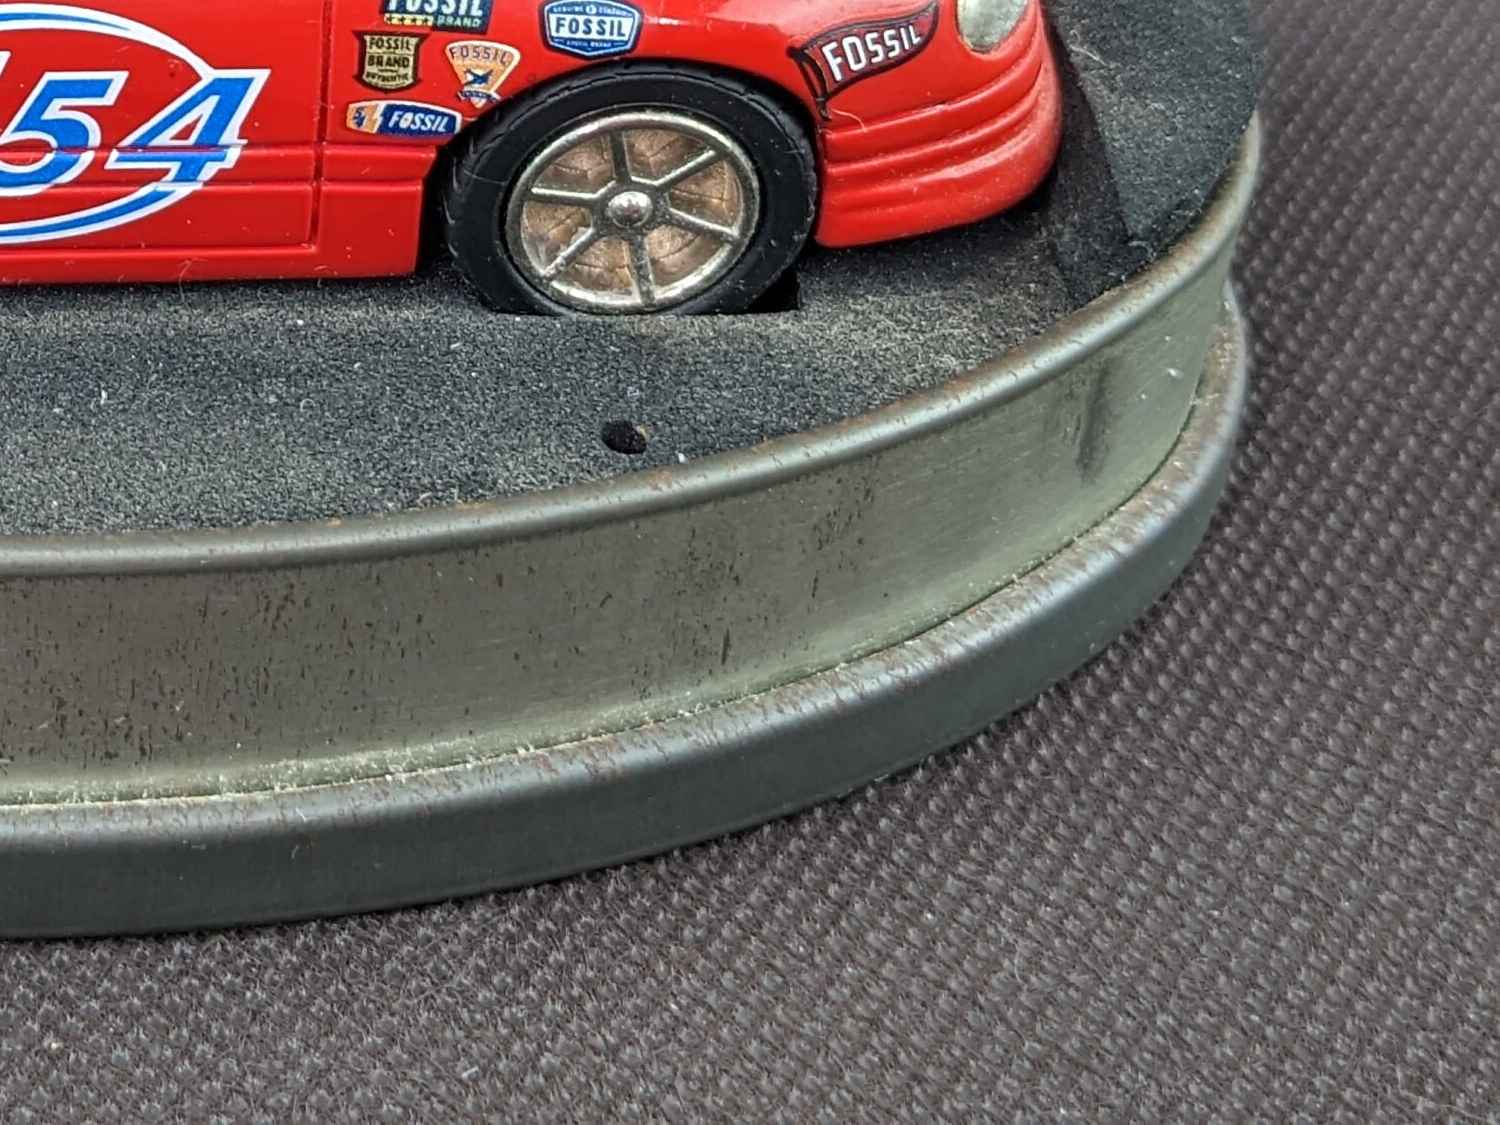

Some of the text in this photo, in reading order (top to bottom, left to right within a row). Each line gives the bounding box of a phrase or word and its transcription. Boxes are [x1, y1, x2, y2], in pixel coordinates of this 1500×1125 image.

[436, 15, 481, 28] BRAND
[554, 16, 627, 37] FOSSIL
[369, 36, 412, 52] FOSSIL
[821, 25, 921, 82] FOSSIL
[367, 55, 411, 69] BRAND
[449, 45, 508, 66] FOSSIL
[388, 110, 449, 132] FOSSIL
